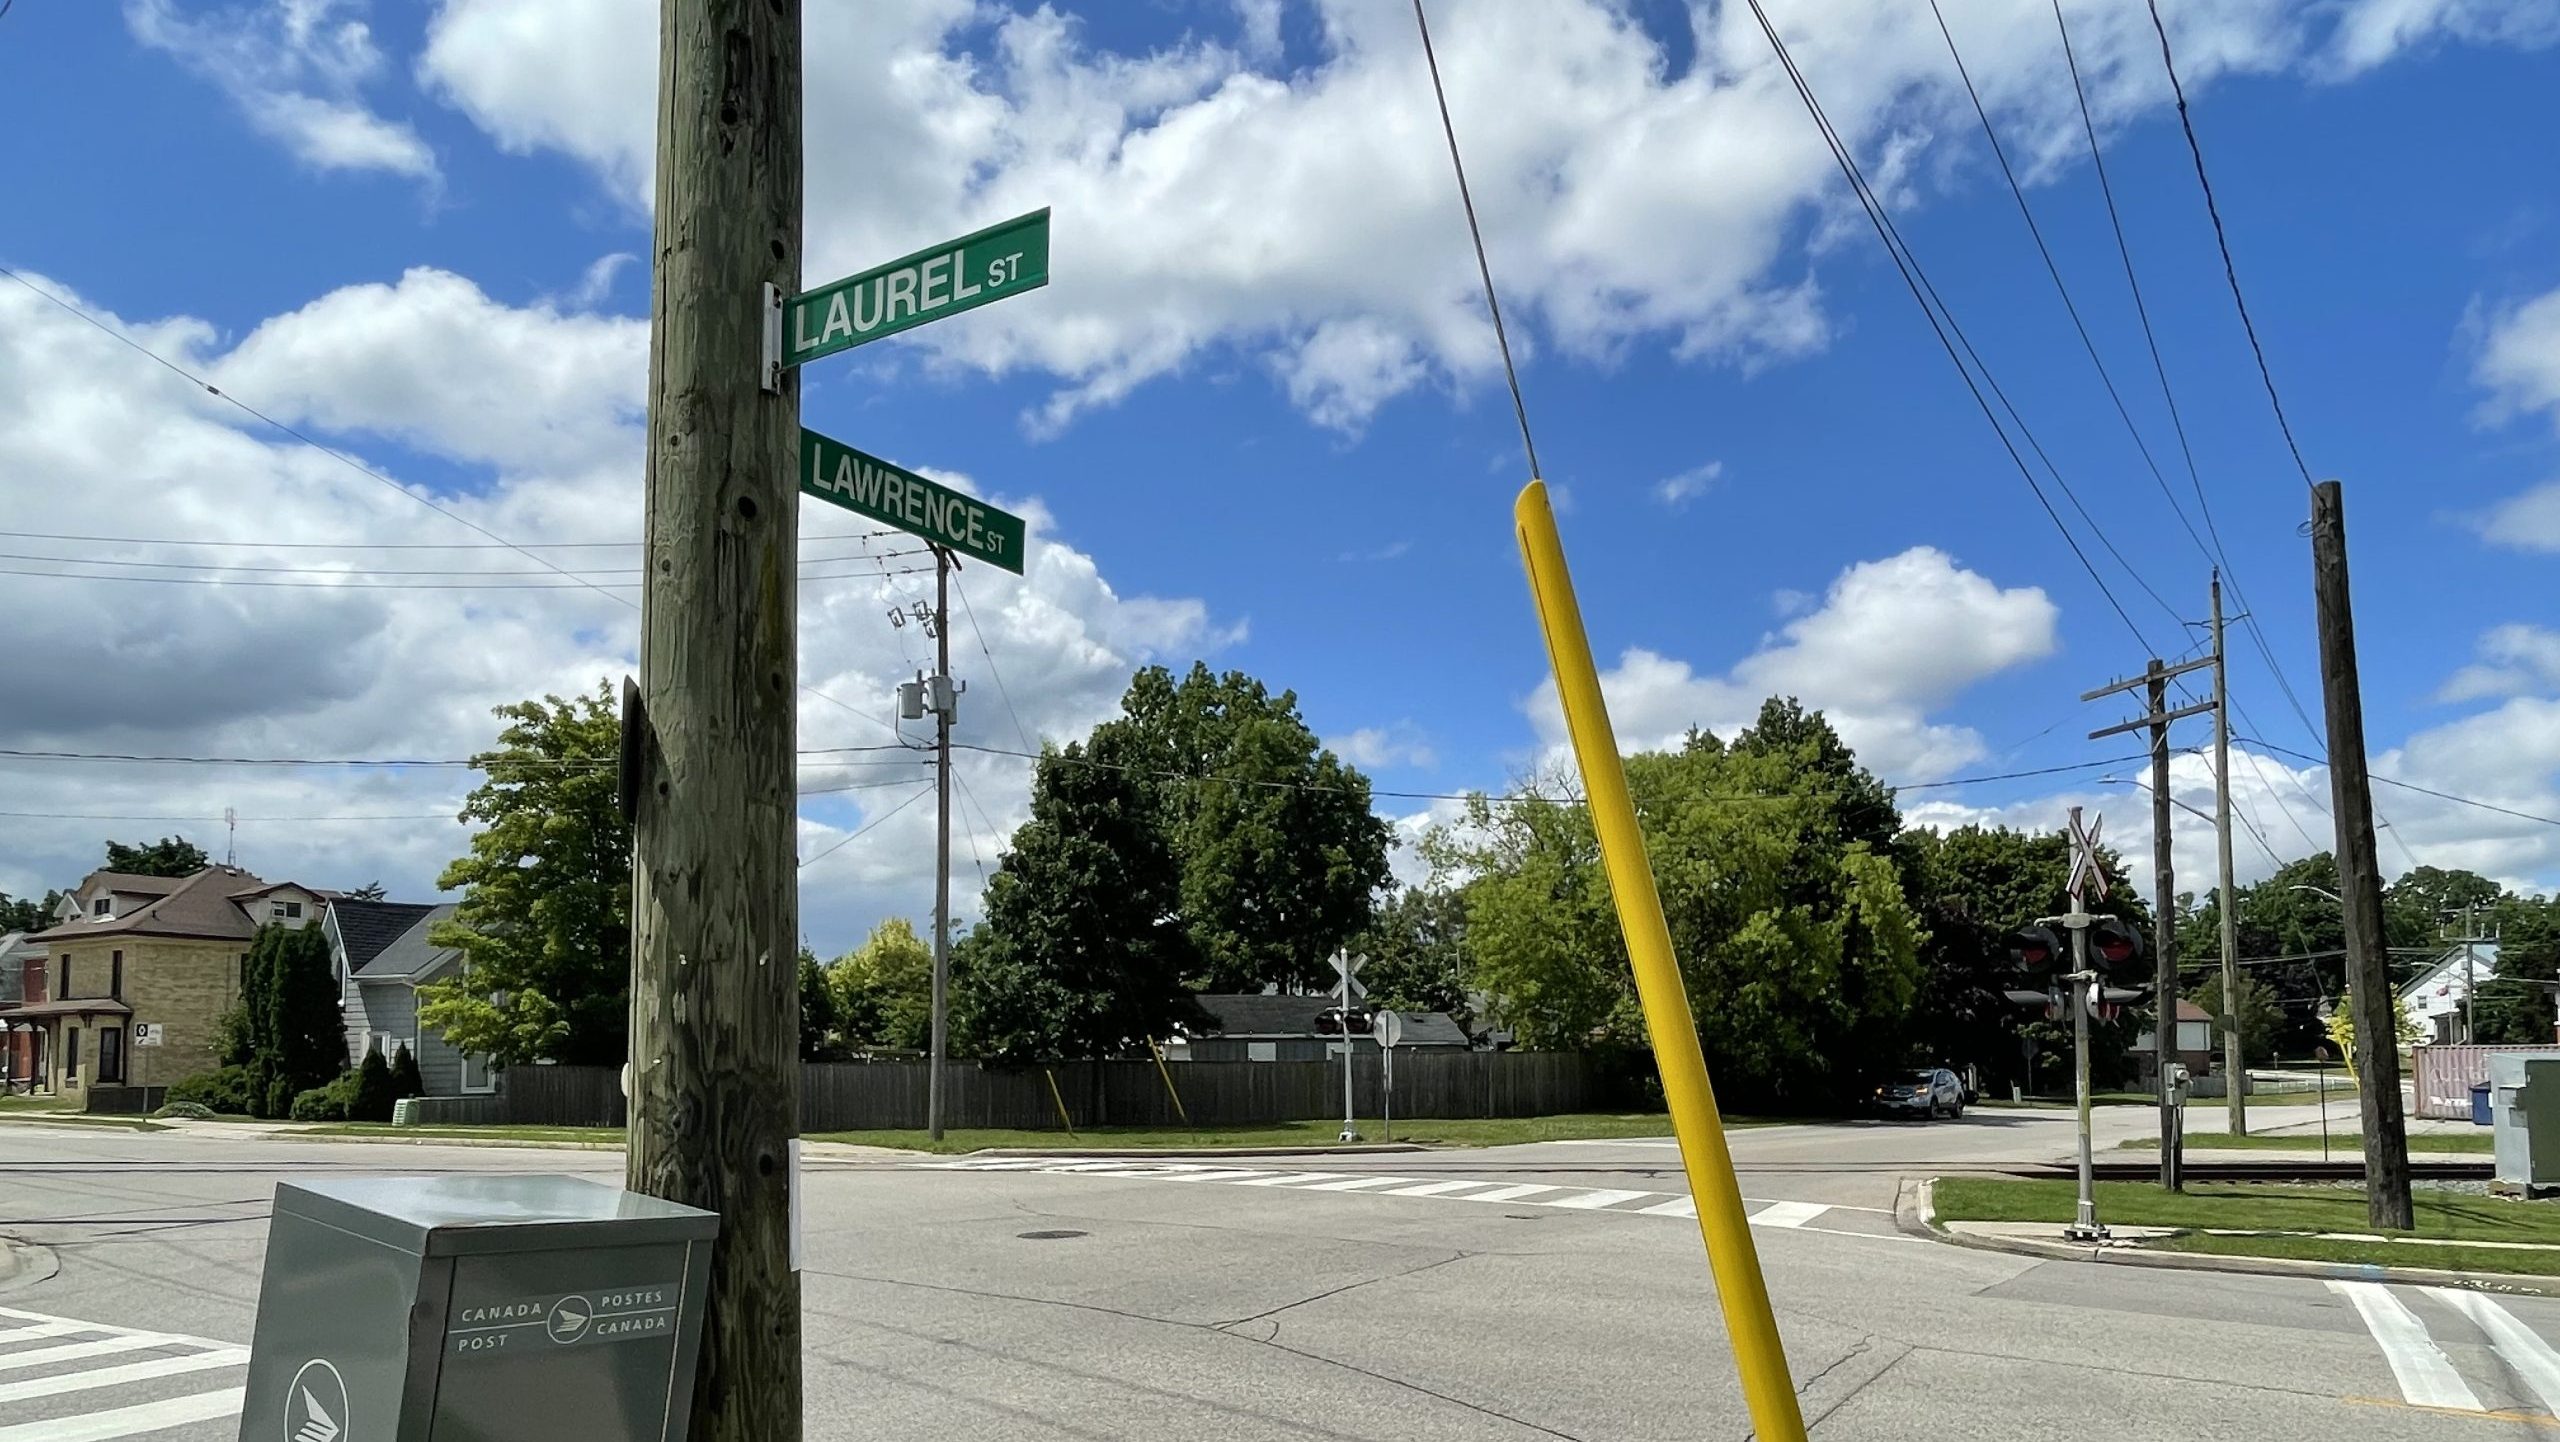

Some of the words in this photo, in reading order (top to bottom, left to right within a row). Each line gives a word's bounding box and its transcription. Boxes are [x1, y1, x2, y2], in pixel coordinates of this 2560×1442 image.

[794, 248, 982, 353] LAUREL
[987, 251, 1024, 288] ST
[812, 442, 985, 550] LAWRENCE
[986, 530, 1005, 554] ST
[601, 1290, 663, 1308] POSTES
[461, 1302, 542, 1322] CANADA
[596, 1316, 667, 1335] CANADA
[458, 1334, 509, 1352] POST
